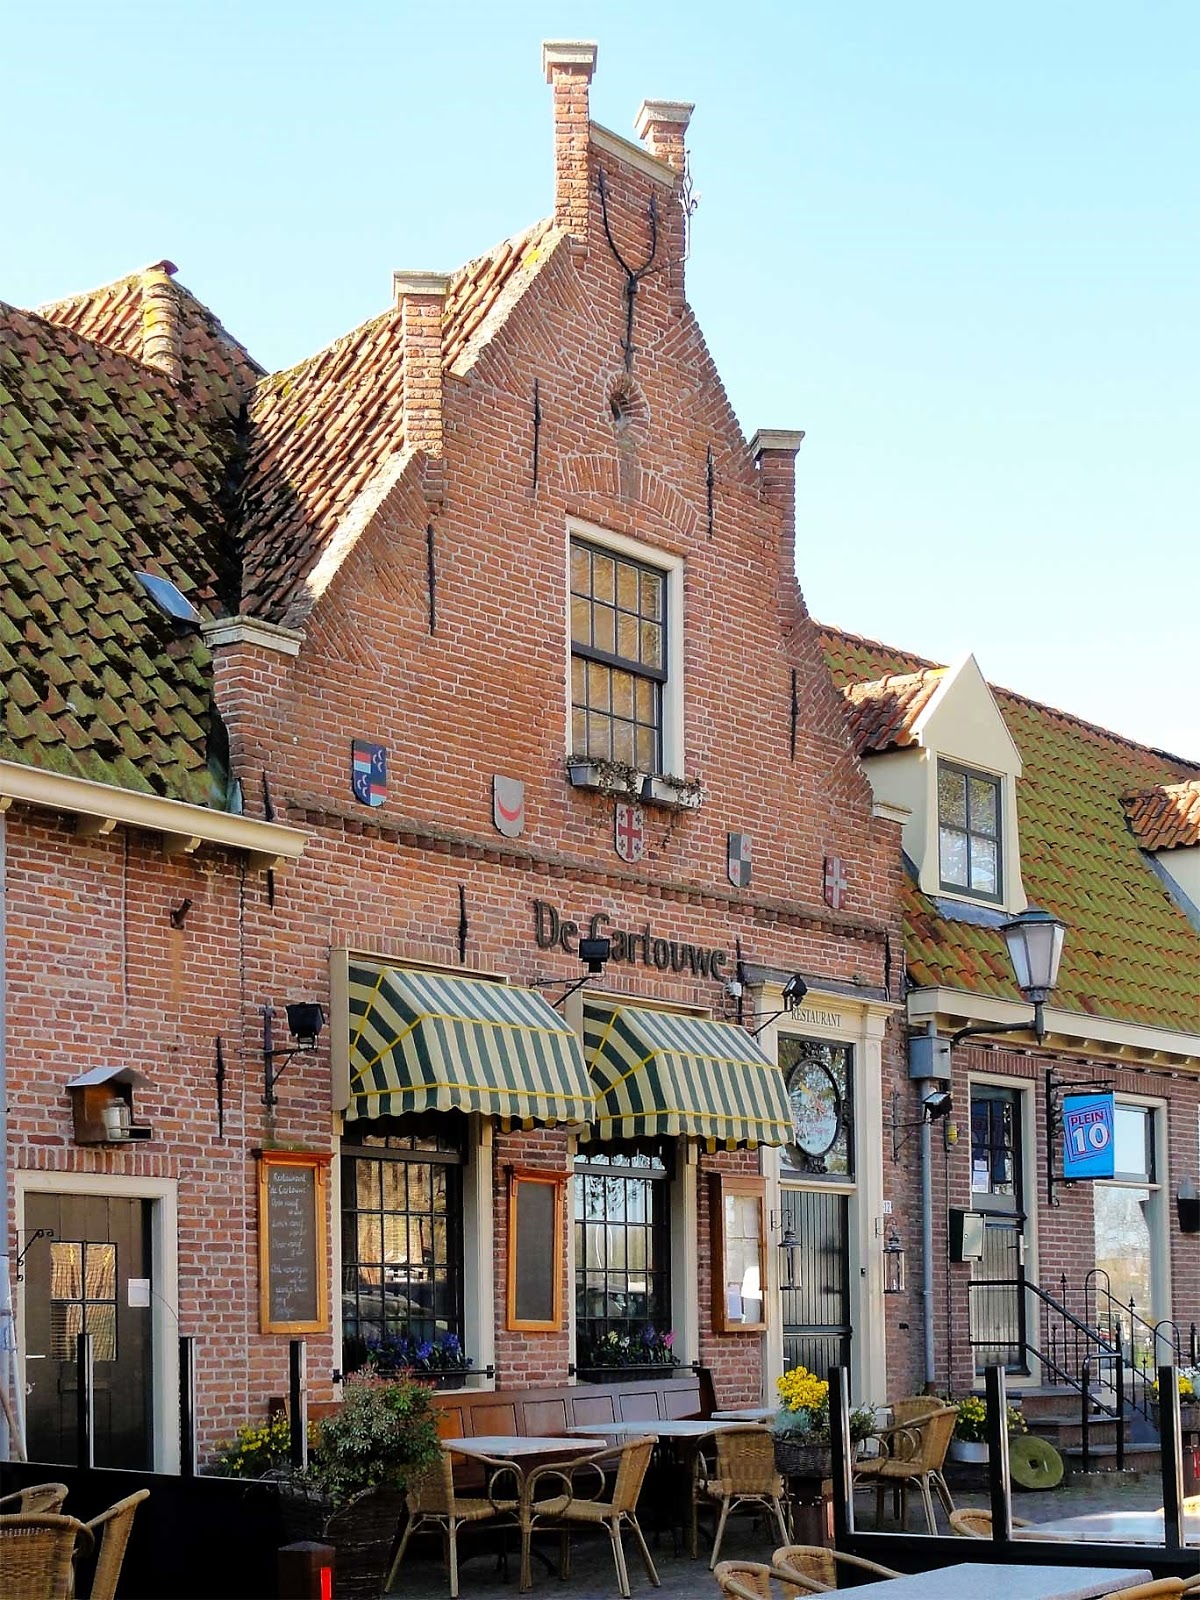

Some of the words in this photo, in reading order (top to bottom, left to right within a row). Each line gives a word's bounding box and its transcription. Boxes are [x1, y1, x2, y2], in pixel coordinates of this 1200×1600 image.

[534, 898, 578, 953] De
[791, 1007, 841, 1027] RESTAURANT
[1070, 1111, 1104, 1127] PLEIN
[1072, 1121, 1110, 1154] 10
